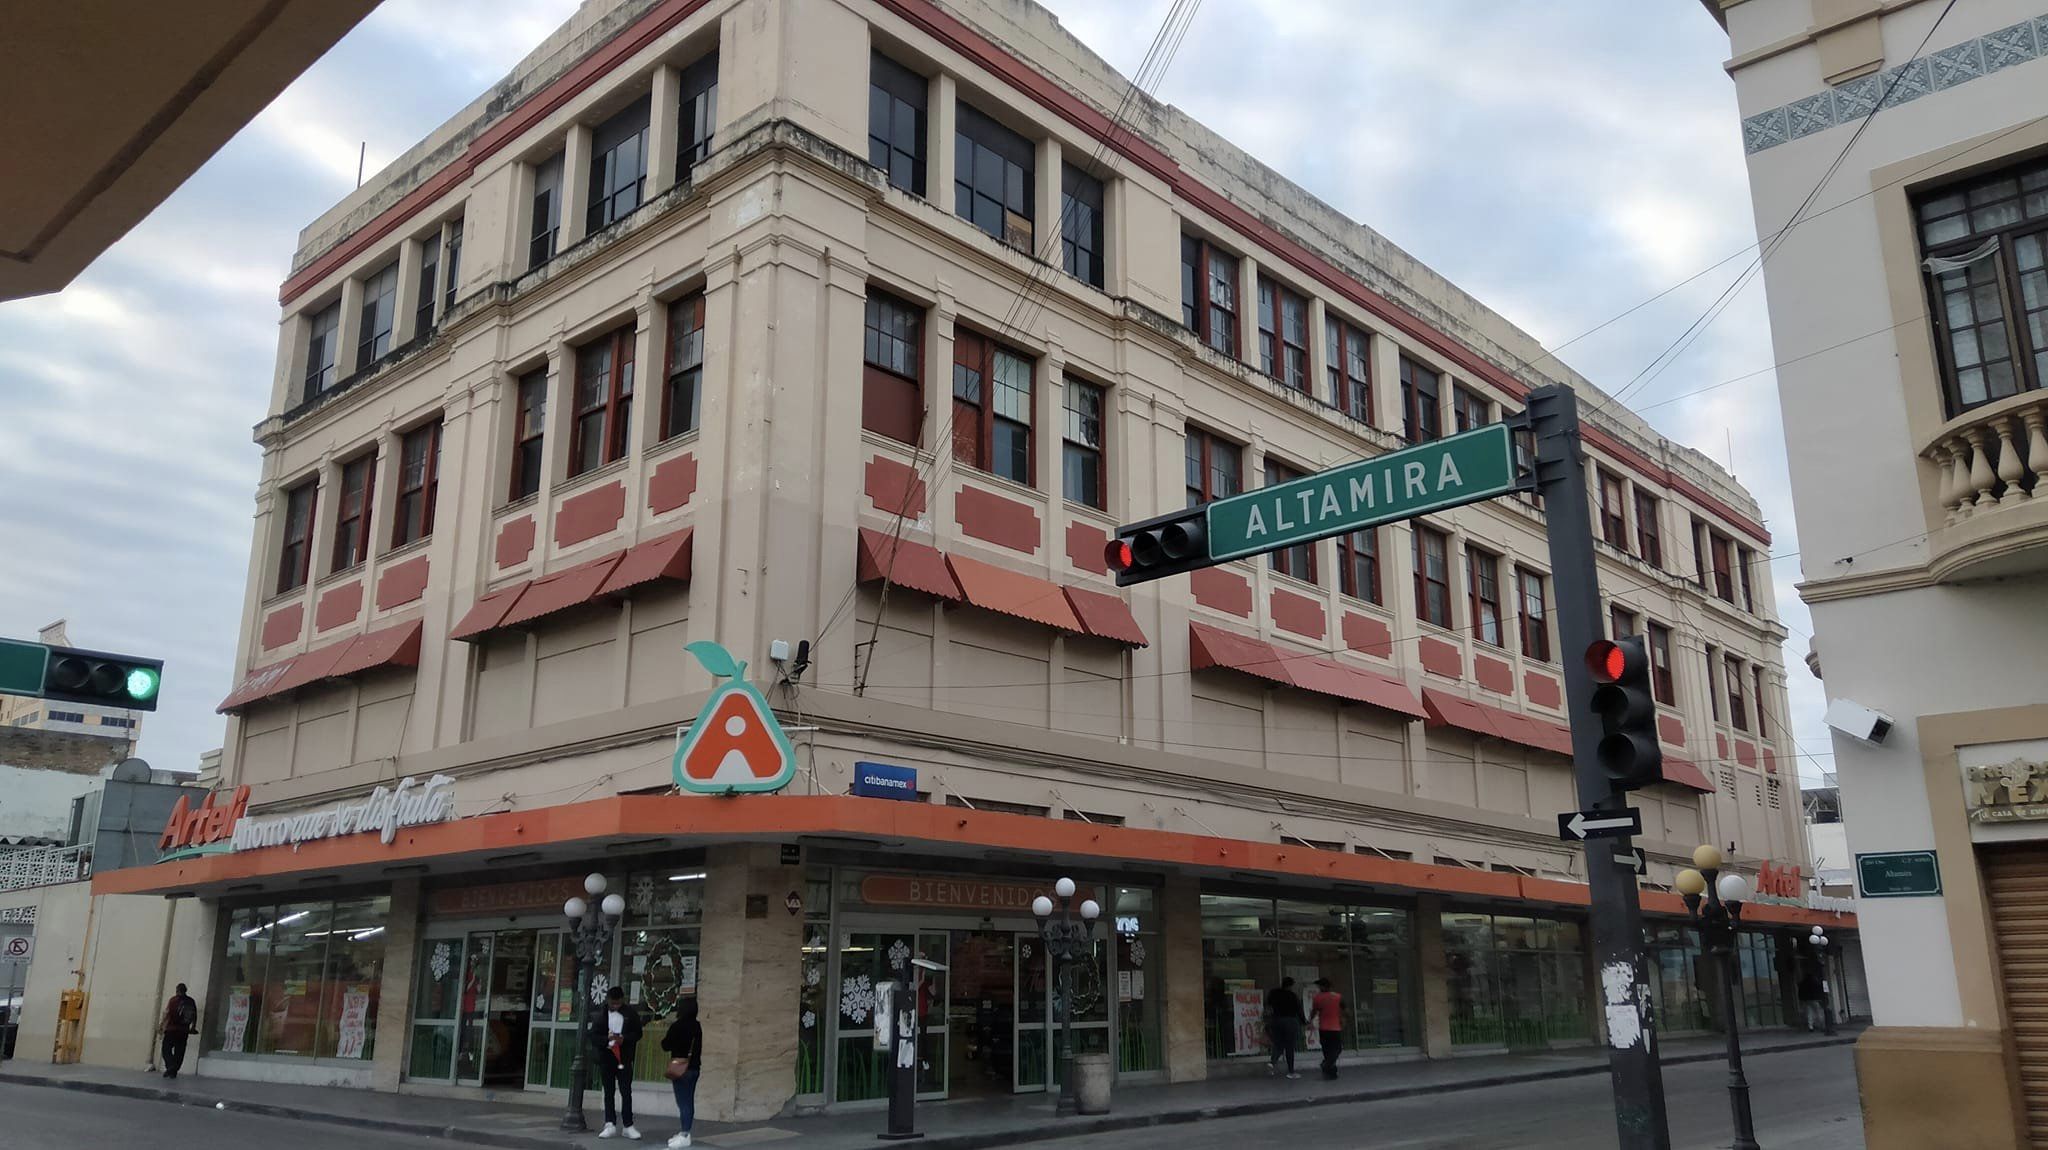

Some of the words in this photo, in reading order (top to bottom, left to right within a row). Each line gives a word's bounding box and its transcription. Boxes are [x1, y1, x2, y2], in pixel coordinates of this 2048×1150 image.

[1245, 452, 1463, 539] ALTAMIRA
[159, 784, 250, 849] Arteli
[229, 802, 292, 852] Ahorro
[289, 810, 328, 853] que
[328, 803, 353, 836] se
[353, 774, 456, 845] disfruta
[864, 775, 907, 789] citibanamex
